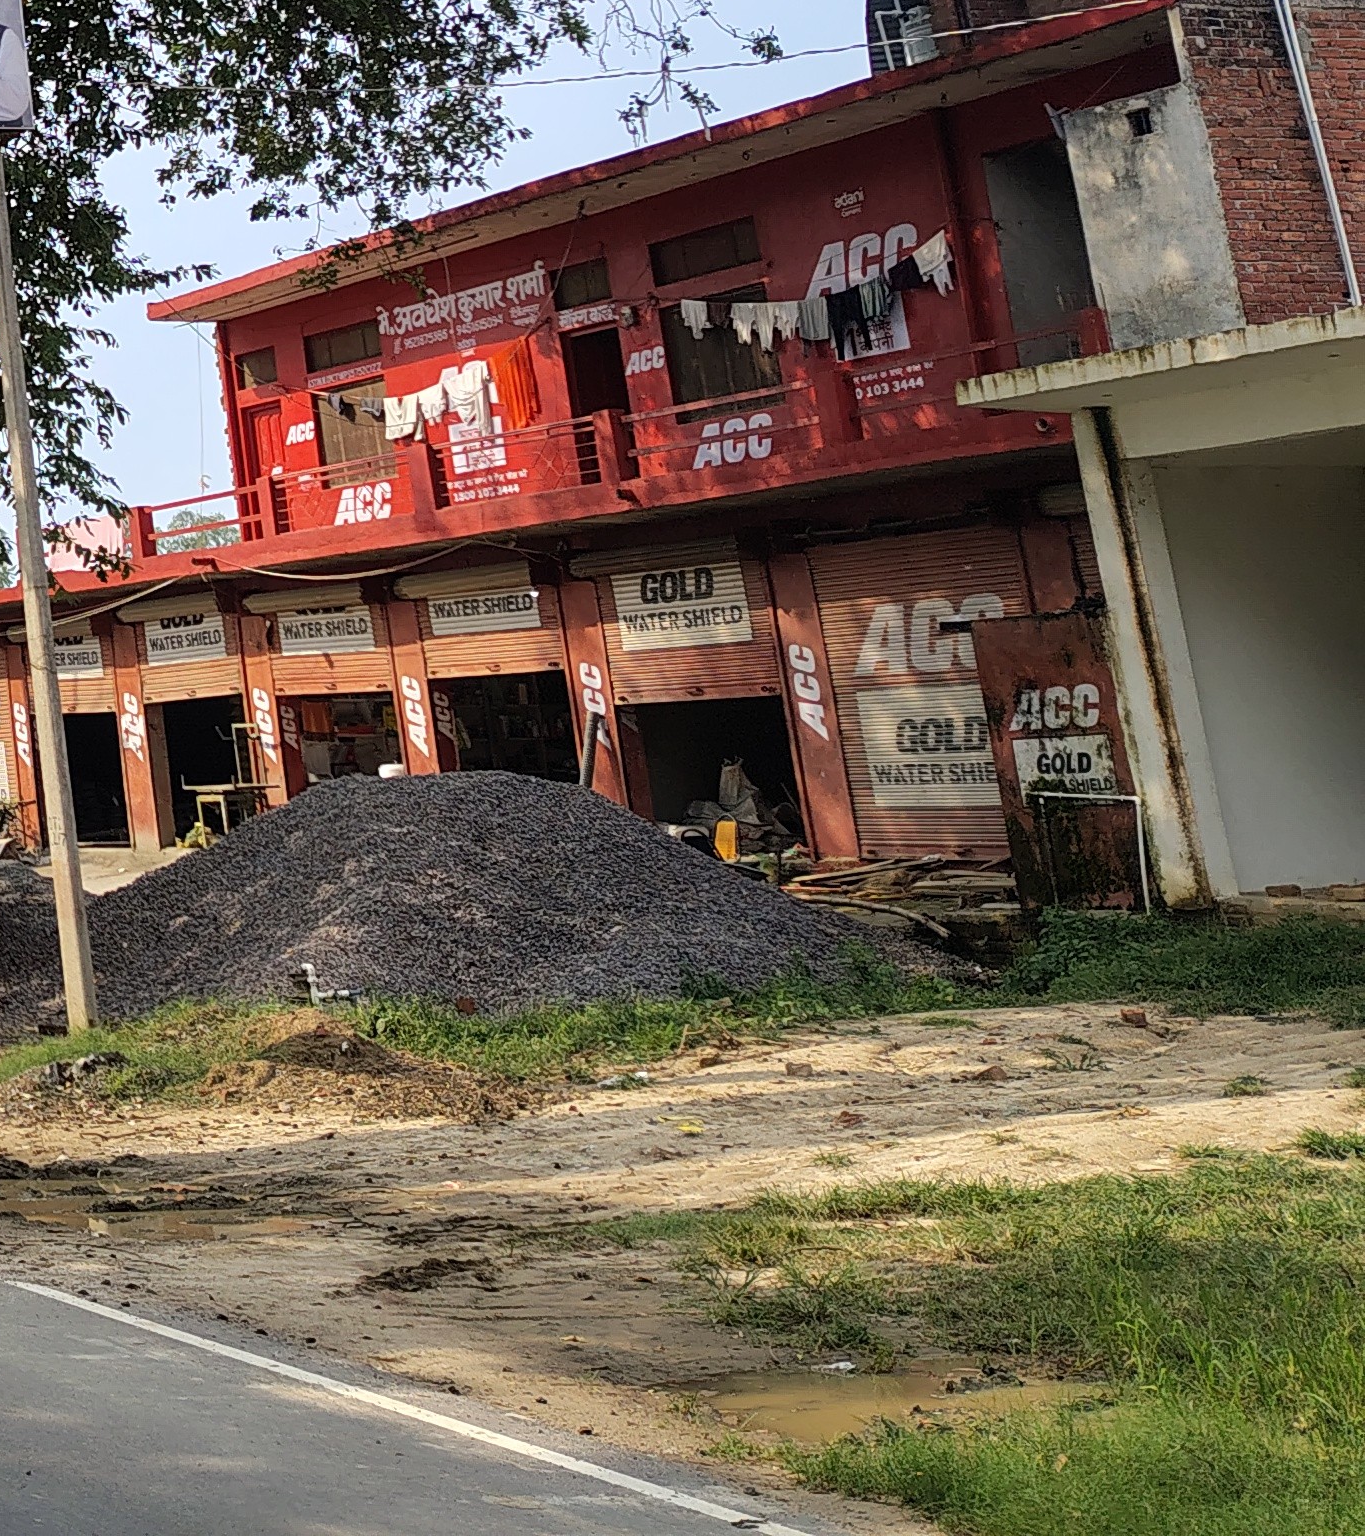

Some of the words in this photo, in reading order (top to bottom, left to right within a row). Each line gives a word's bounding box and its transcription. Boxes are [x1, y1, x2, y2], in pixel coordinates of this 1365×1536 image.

[456, 280, 507, 324] कुमार
[505, 259, 547, 305] शर्मा
[625, 346, 665, 376] ACC
[892, 375, 925, 392] 3444
[285, 421, 315, 446] ACC
[692, 413, 773, 470] ACC
[333, 482, 392, 526] ACC
[640, 567, 715, 604] GOLD
[433, 596, 480, 618] WATER
[481, 593, 534, 614] SHIELD
[623, 611, 680, 633] WATER
[683, 604, 743, 629] SHIELD
[149, 634, 184, 652] WATER
[185, 629, 222, 647] SHIELD
[282, 621, 323, 640] WATER
[325, 617, 368, 637] SHIELD
[66, 650, 100, 666] SHIELD
[788, 644, 829, 742] ACC
[1009, 683, 1100, 732] ACC
[122, 692, 144, 762] ACC
[252, 687, 277, 764] ACC
[282, 704, 299, 750] ACC
[401, 675, 429, 758] ACC
[433, 690, 456, 739] ACC
[13, 702, 31, 768] ACC
[896, 716, 988, 754] GOLD
[872, 763, 946, 785] WATER
[1036, 752, 1092, 775] GOLD
[1067, 777, 1114, 793] SHIELD
